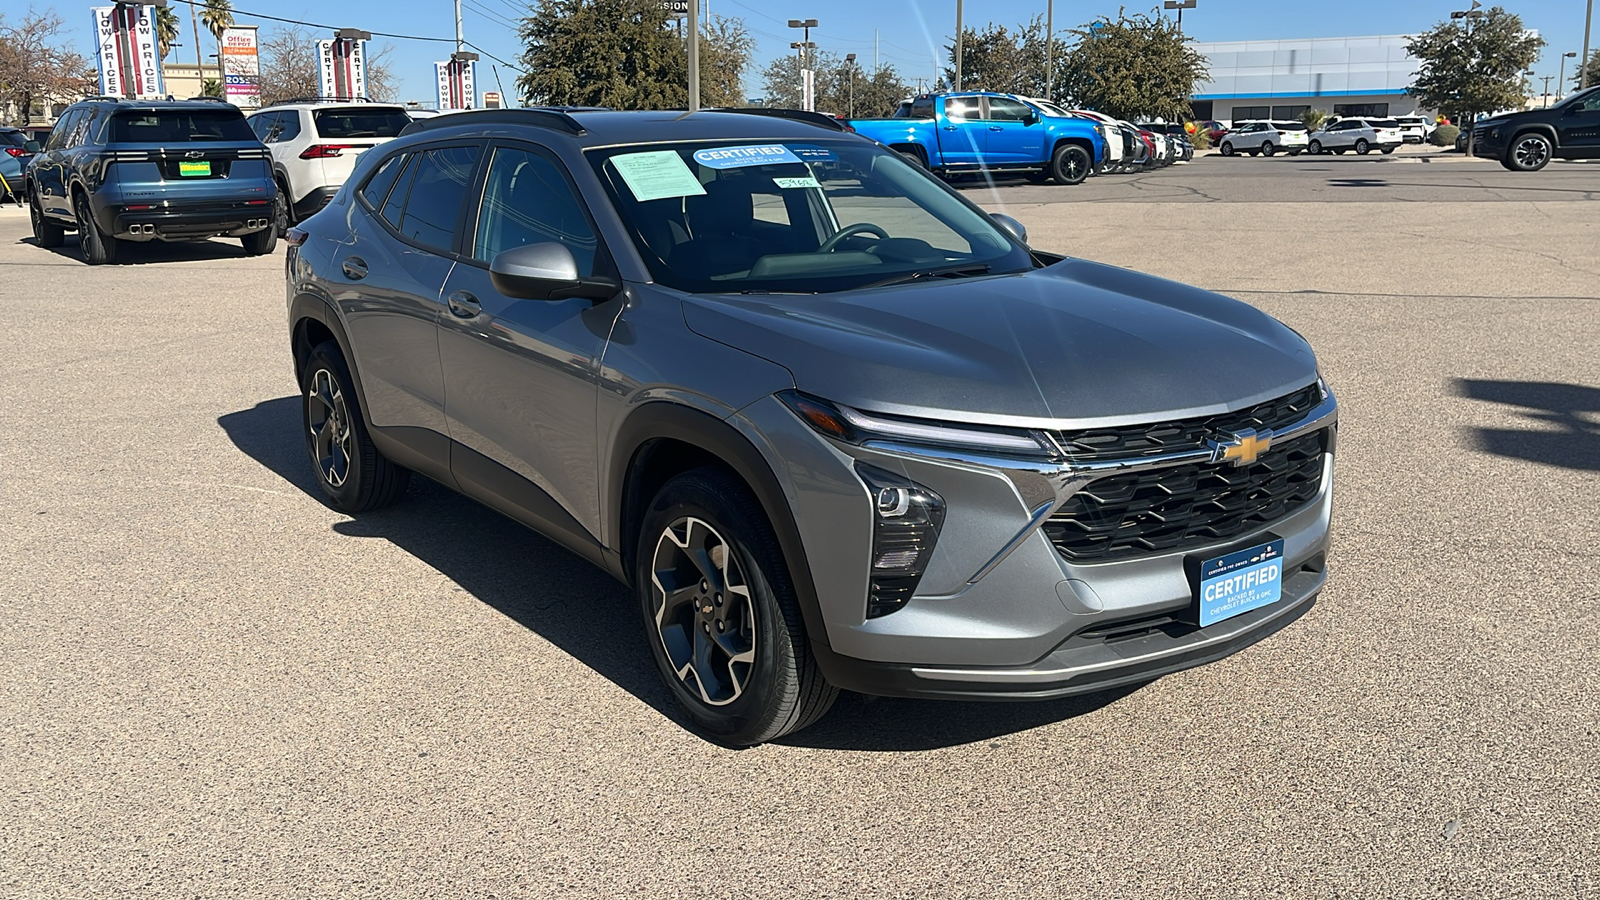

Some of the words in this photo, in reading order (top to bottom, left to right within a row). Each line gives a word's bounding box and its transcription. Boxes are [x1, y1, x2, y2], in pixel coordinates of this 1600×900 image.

[101, 11, 112, 36] LOW
[139, 10, 150, 35] LOW
[104, 44, 117, 93] PRICES
[142, 43, 156, 93] PRICES
[439, 65, 448, 82] PRE
[463, 63, 471, 81] PRE
[697, 146, 786, 161] CERTIFIED
[1204, 564, 1278, 602] CERTIFIED
[1227, 591, 1247, 603] BACKED
[1248, 589, 1255, 597] BY
[1240, 595, 1256, 605] BUICK
[1260, 589, 1272, 598] GMC
